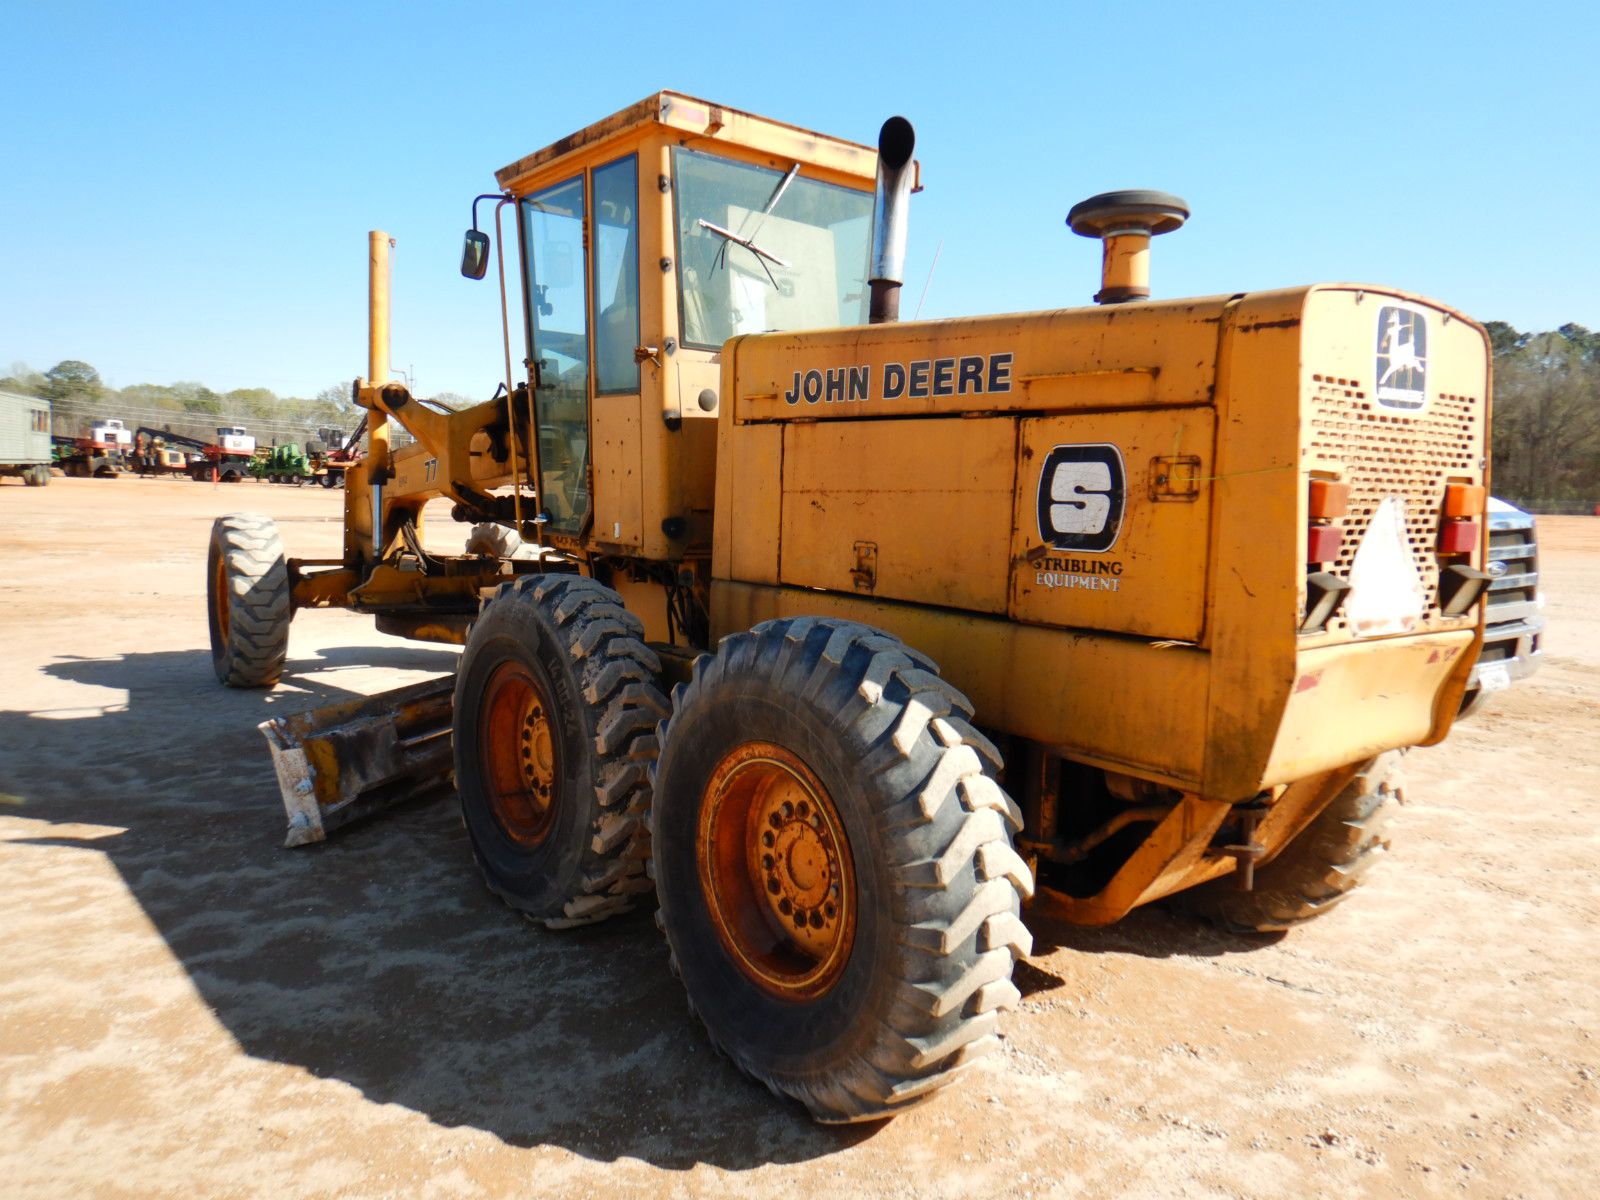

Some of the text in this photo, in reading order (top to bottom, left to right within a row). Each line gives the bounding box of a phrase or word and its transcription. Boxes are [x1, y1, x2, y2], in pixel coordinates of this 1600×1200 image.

[785, 352, 1014, 406] JOHN DEERE
[1050, 461, 1112, 535] S
[1033, 557, 1123, 575] STRIBLING
[1036, 572, 1120, 592] EQUIPMENT
